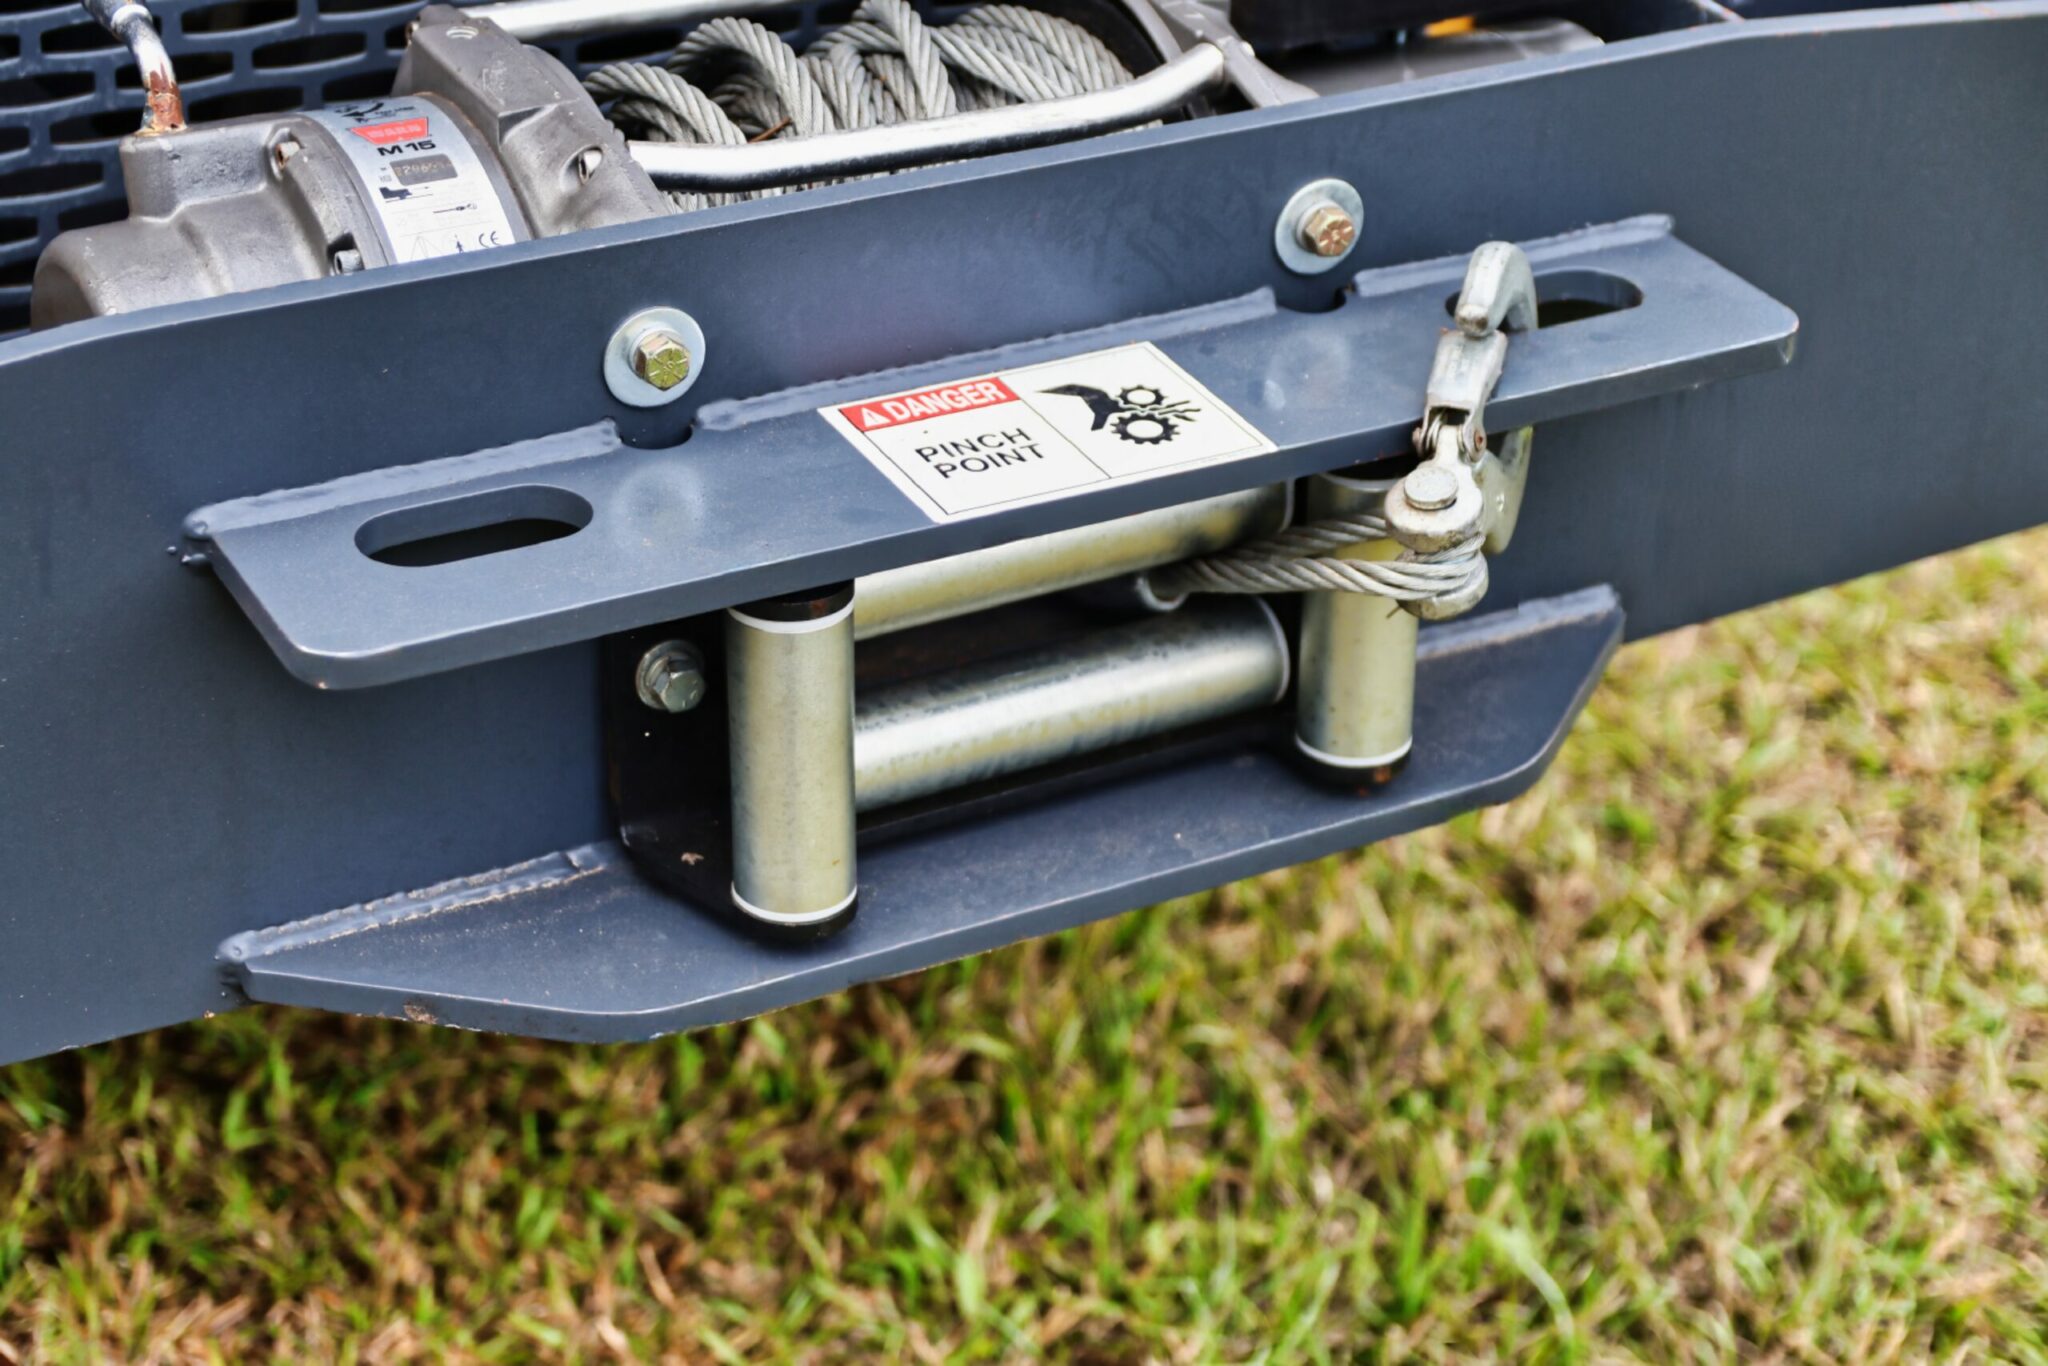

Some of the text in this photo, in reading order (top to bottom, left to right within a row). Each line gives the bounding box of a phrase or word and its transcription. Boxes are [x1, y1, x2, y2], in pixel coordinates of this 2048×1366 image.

[882, 381, 1007, 421] DANGER
[915, 428, 1032, 462] PINCH
[934, 443, 1044, 479] POINT
